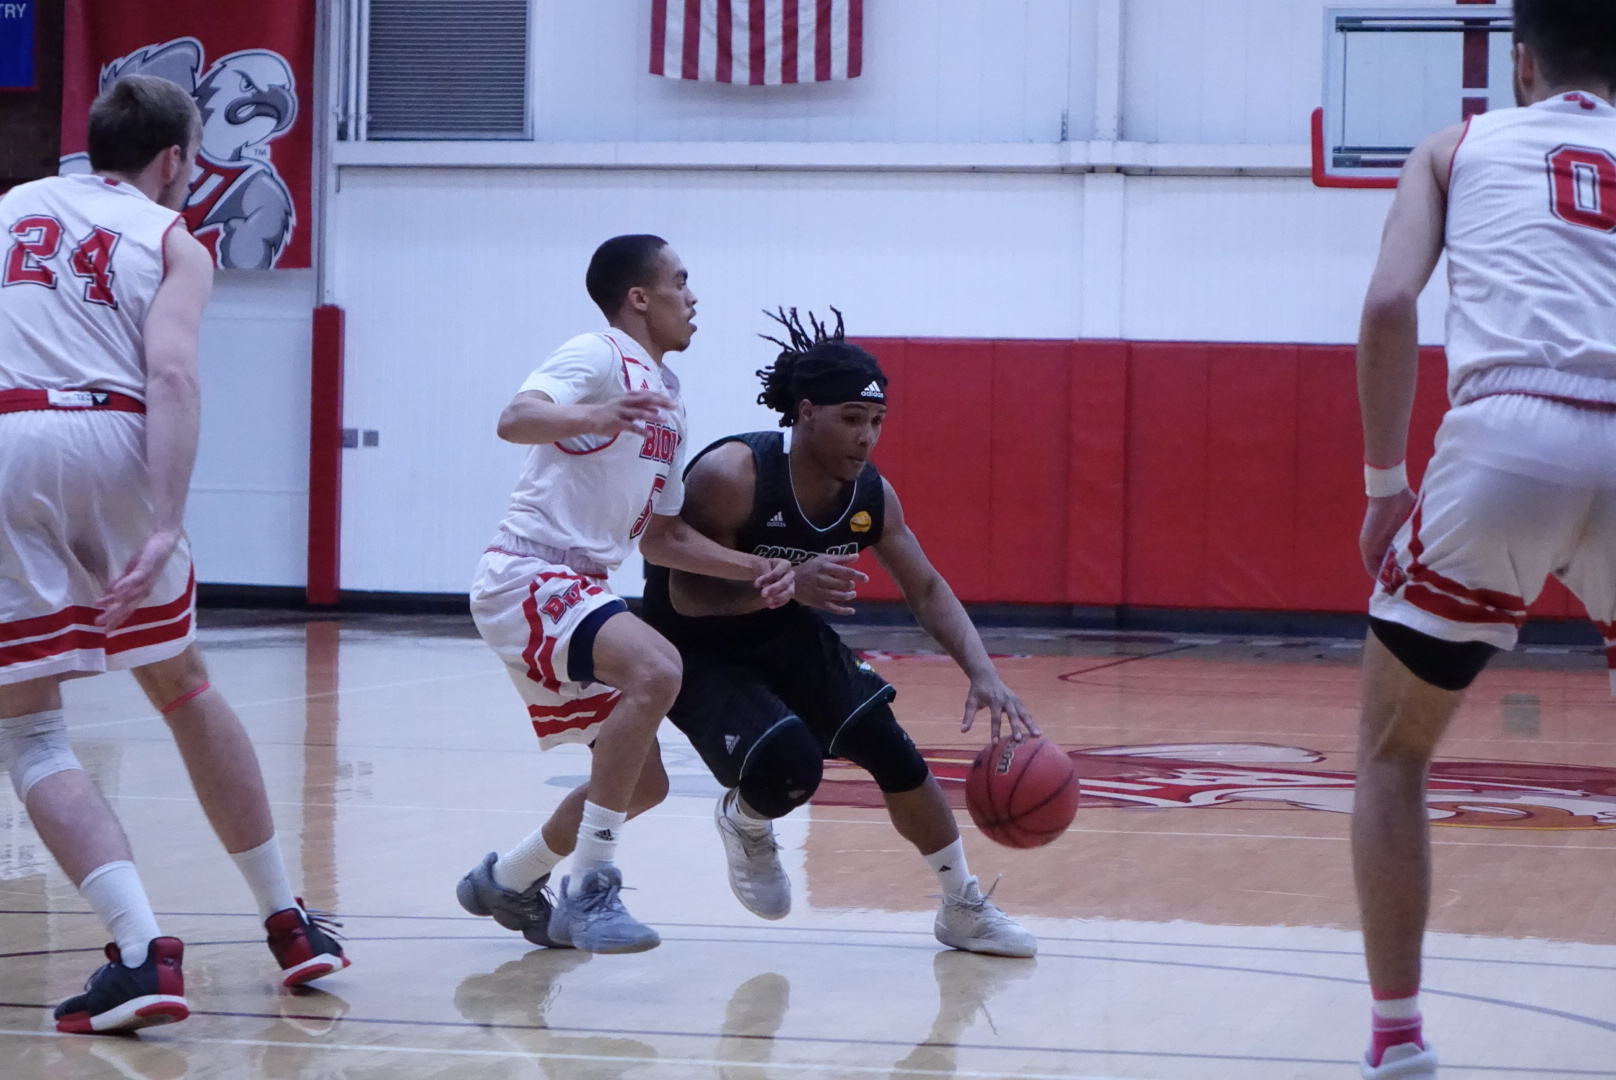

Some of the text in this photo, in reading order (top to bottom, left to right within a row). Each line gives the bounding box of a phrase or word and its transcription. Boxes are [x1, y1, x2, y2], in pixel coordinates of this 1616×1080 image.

[1545, 143, 1616, 234] 0
[2, 213, 122, 311] 24
[861, 391, 884, 399] adidas
[751, 542, 859, 564] CONCODIA
